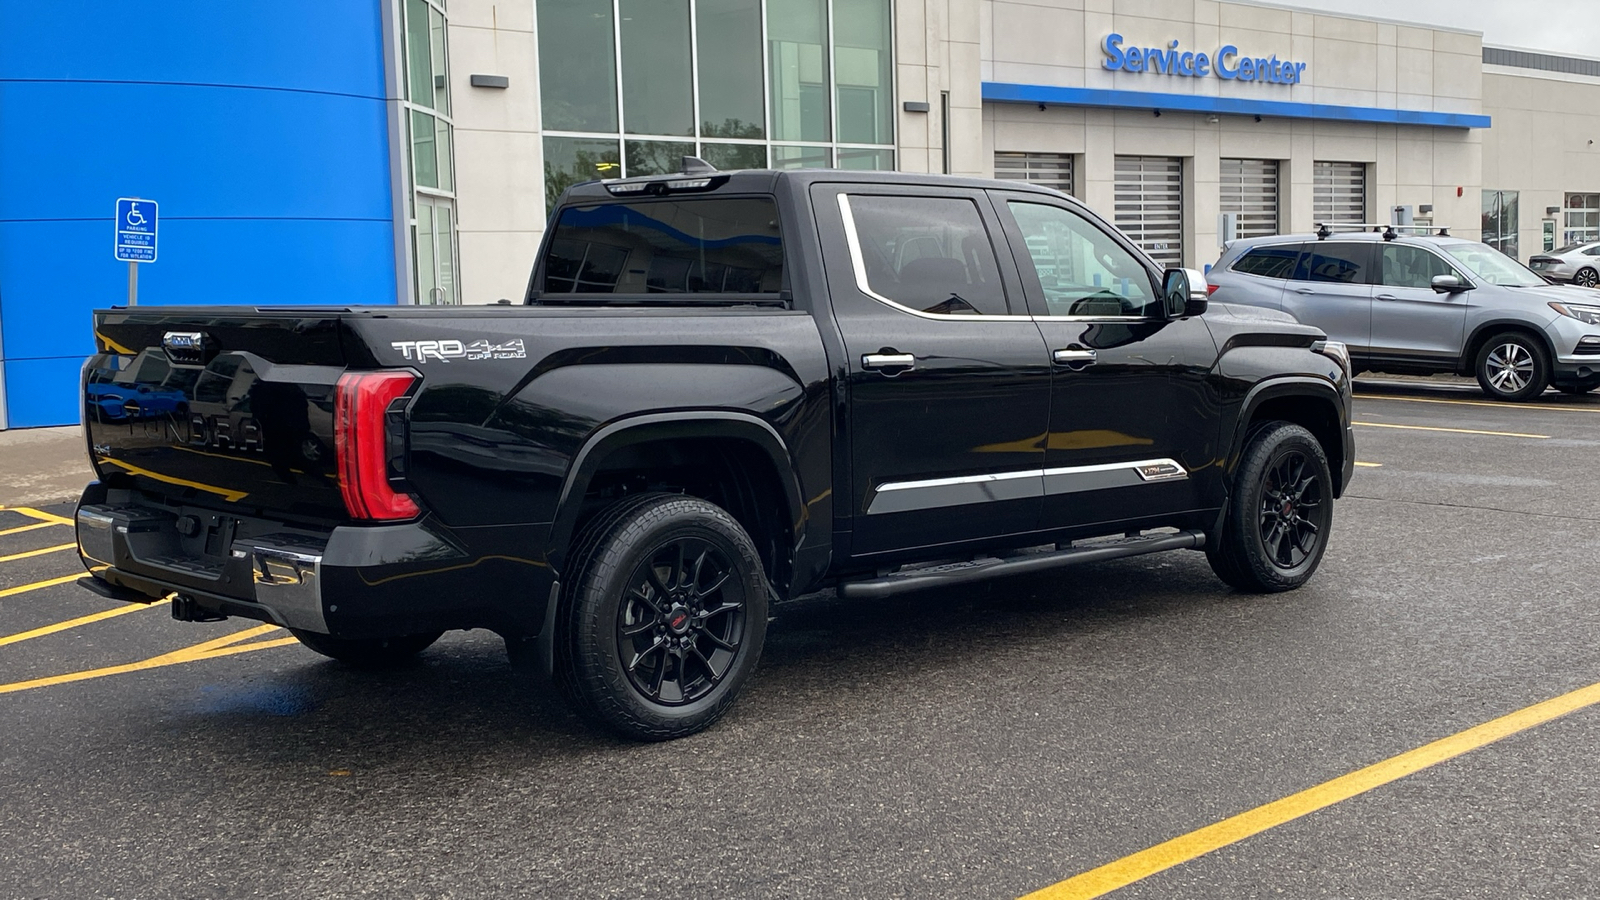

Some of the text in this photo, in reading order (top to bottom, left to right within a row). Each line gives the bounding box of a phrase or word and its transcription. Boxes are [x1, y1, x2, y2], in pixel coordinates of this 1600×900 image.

[1101, 32, 1307, 84] Service Center
[391, 340, 465, 363] TRD
[467, 352, 526, 360] OFF ROAD
